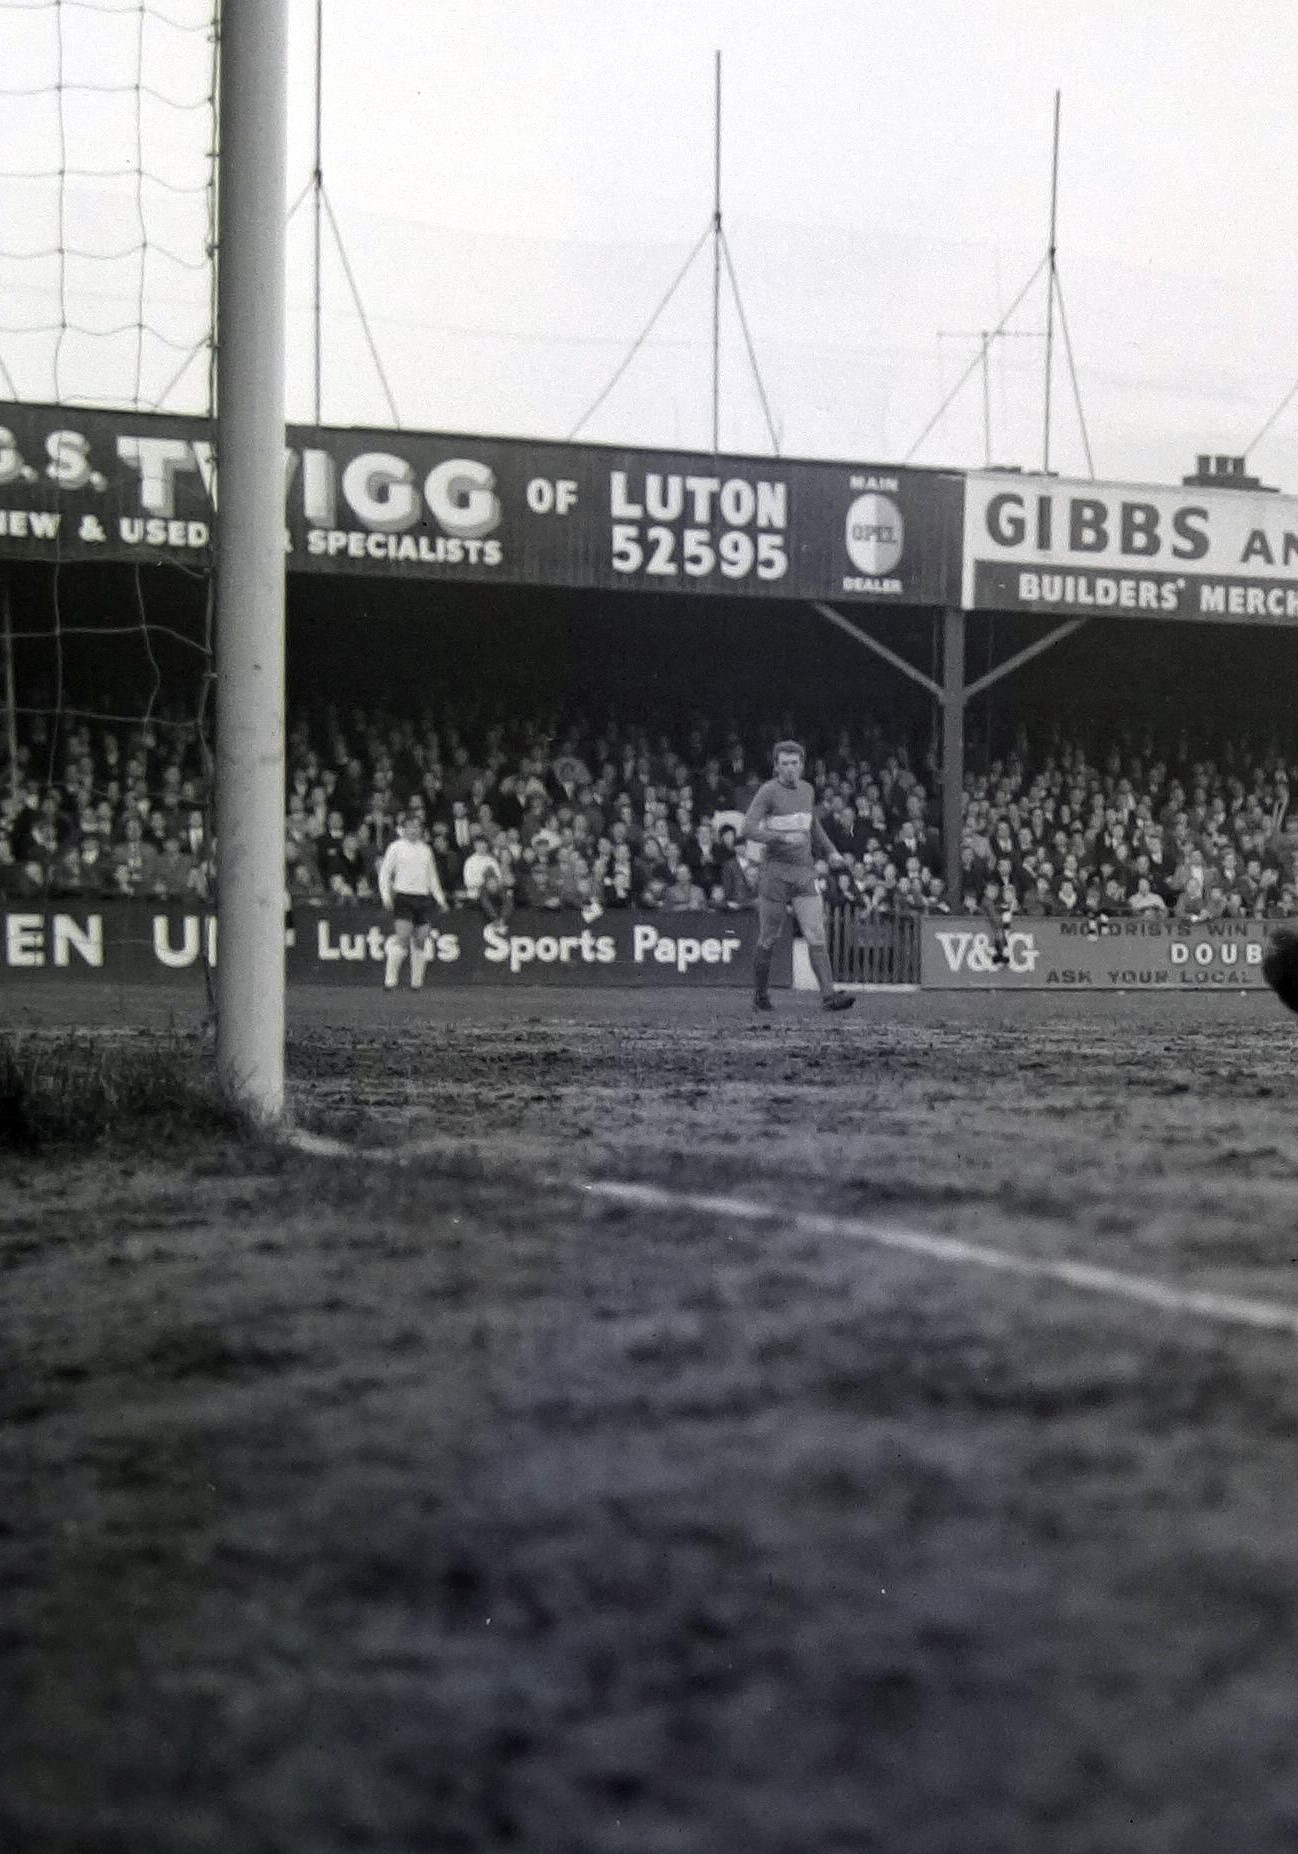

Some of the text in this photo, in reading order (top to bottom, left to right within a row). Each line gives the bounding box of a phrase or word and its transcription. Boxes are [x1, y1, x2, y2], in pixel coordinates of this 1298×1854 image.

[526, 479, 580, 516] OF
[610, 470, 787, 529] LUTON
[78, 514, 107, 543] &
[119, 516, 209, 548] USED
[307, 528, 503, 566] SPECIALISTS
[611, 524, 788, 581] 52595
[985, 493, 1210, 561] GIBBS
[152, 914, 217, 968] U
[483, 922, 617, 973] Sports
[633, 924, 741, 973] Paper
[1170, 942, 1263, 966] DOUB
[1046, 968, 1093, 984] ASK
[1107, 970, 1169, 985] YOUR
